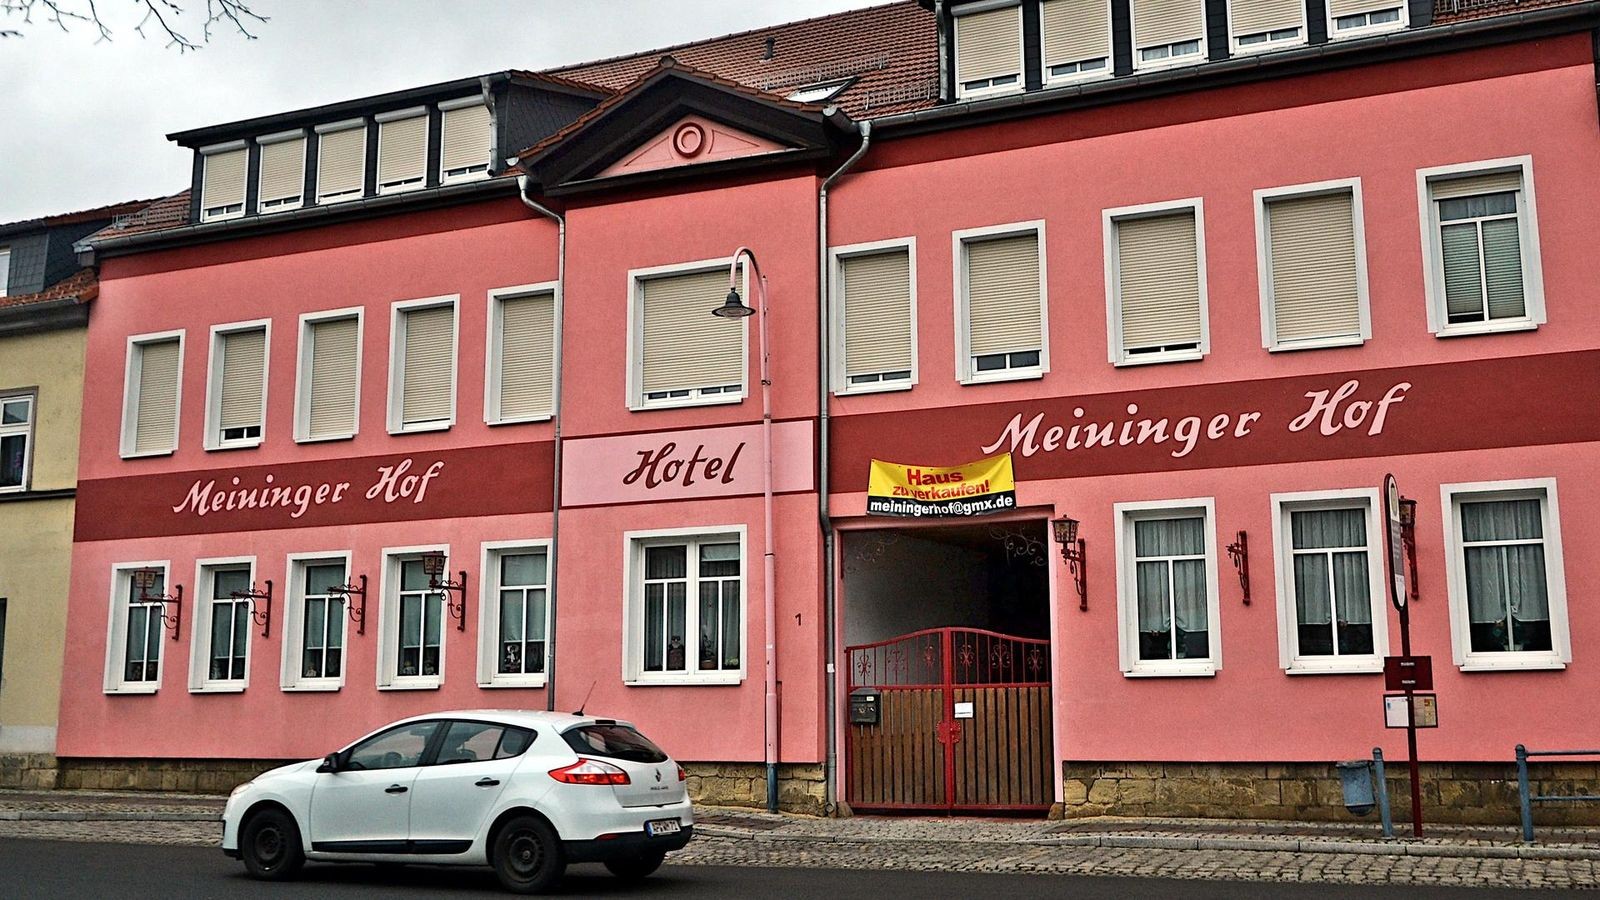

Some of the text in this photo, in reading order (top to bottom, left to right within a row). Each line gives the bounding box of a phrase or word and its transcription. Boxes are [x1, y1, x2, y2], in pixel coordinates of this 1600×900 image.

[981, 380, 1412, 458] Meininger Hof
[622, 442, 746, 490] Hotel
[172, 458, 445, 518] Meininger Hof
[907, 469, 963, 486] Haus
[892, 479, 990, 500] zu verkaufen!
[870, 495, 1013, 516] meiningerhof@gmx.de
[794, 612, 802, 626] 1
